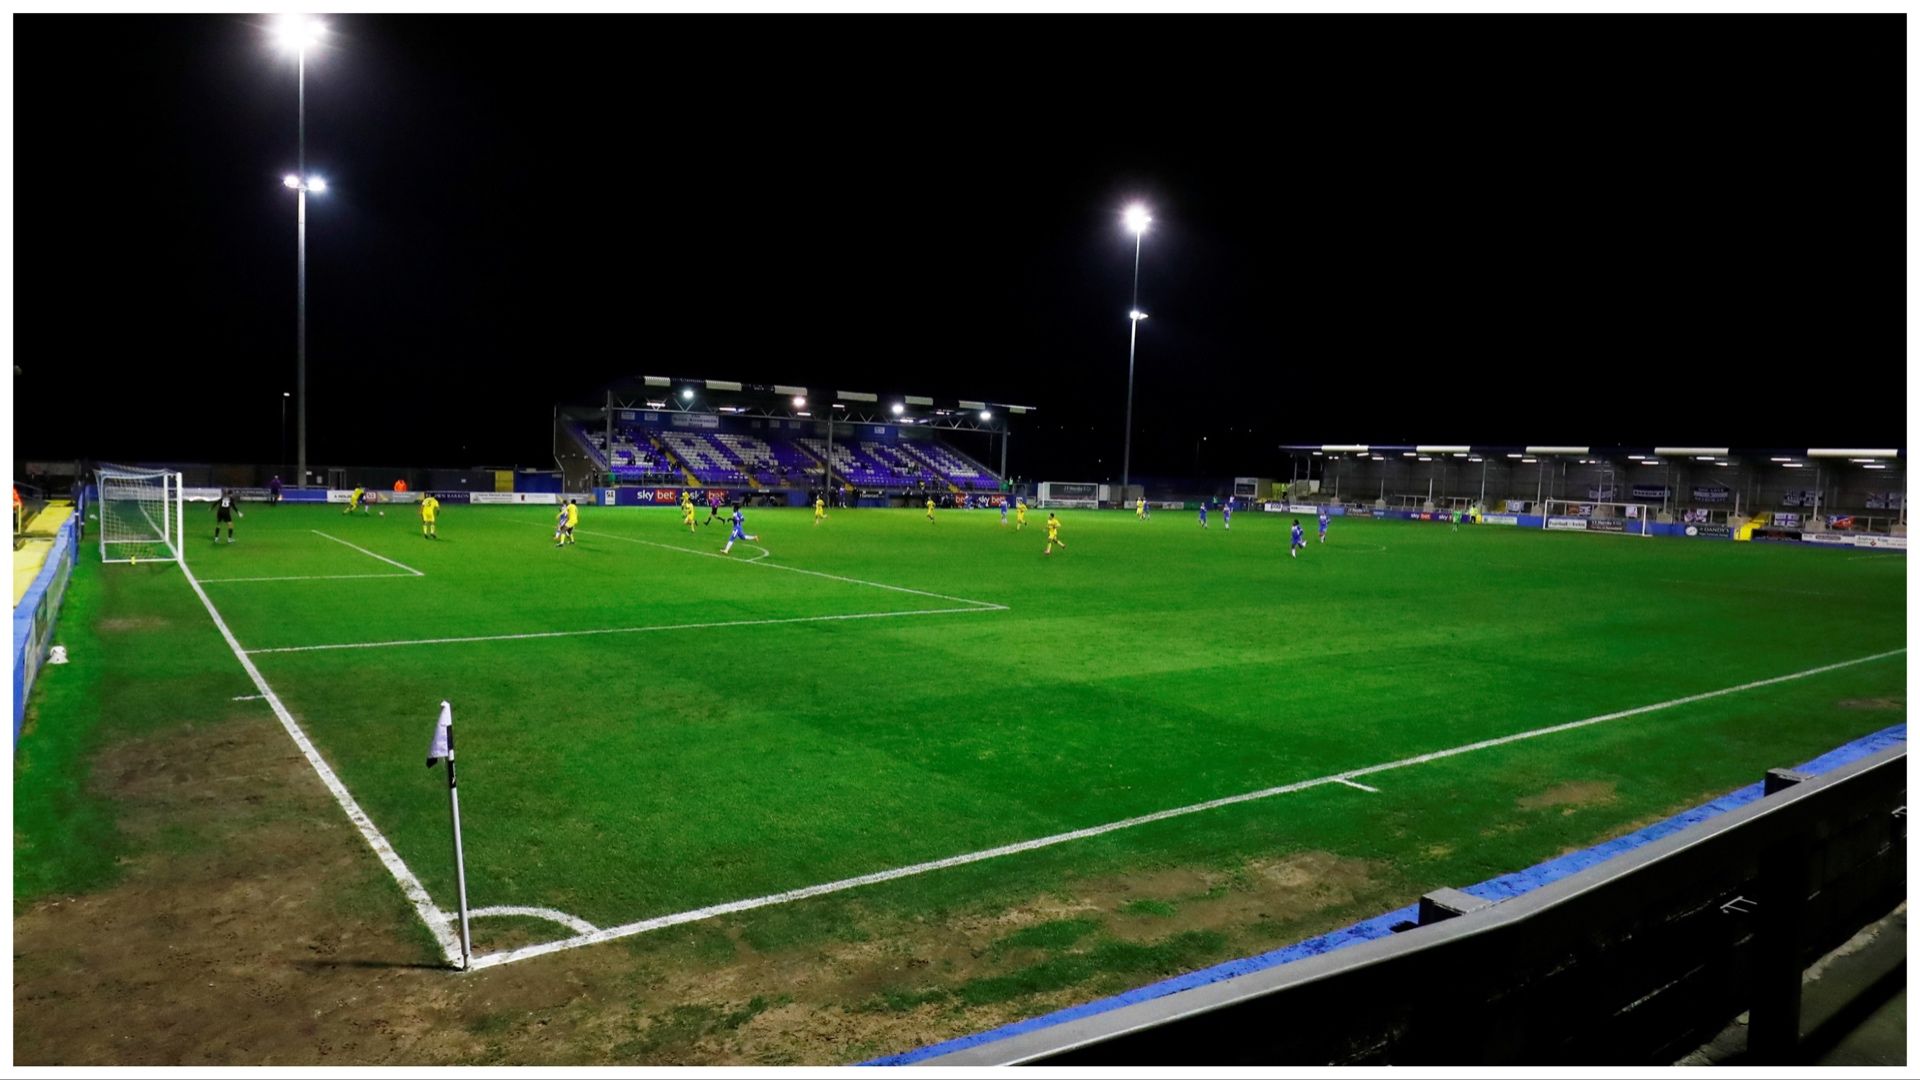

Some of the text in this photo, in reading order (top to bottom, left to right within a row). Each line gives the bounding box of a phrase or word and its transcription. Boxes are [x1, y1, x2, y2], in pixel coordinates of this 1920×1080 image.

[637, 489, 674, 502] sky bet
[978, 495, 991, 507] sky
